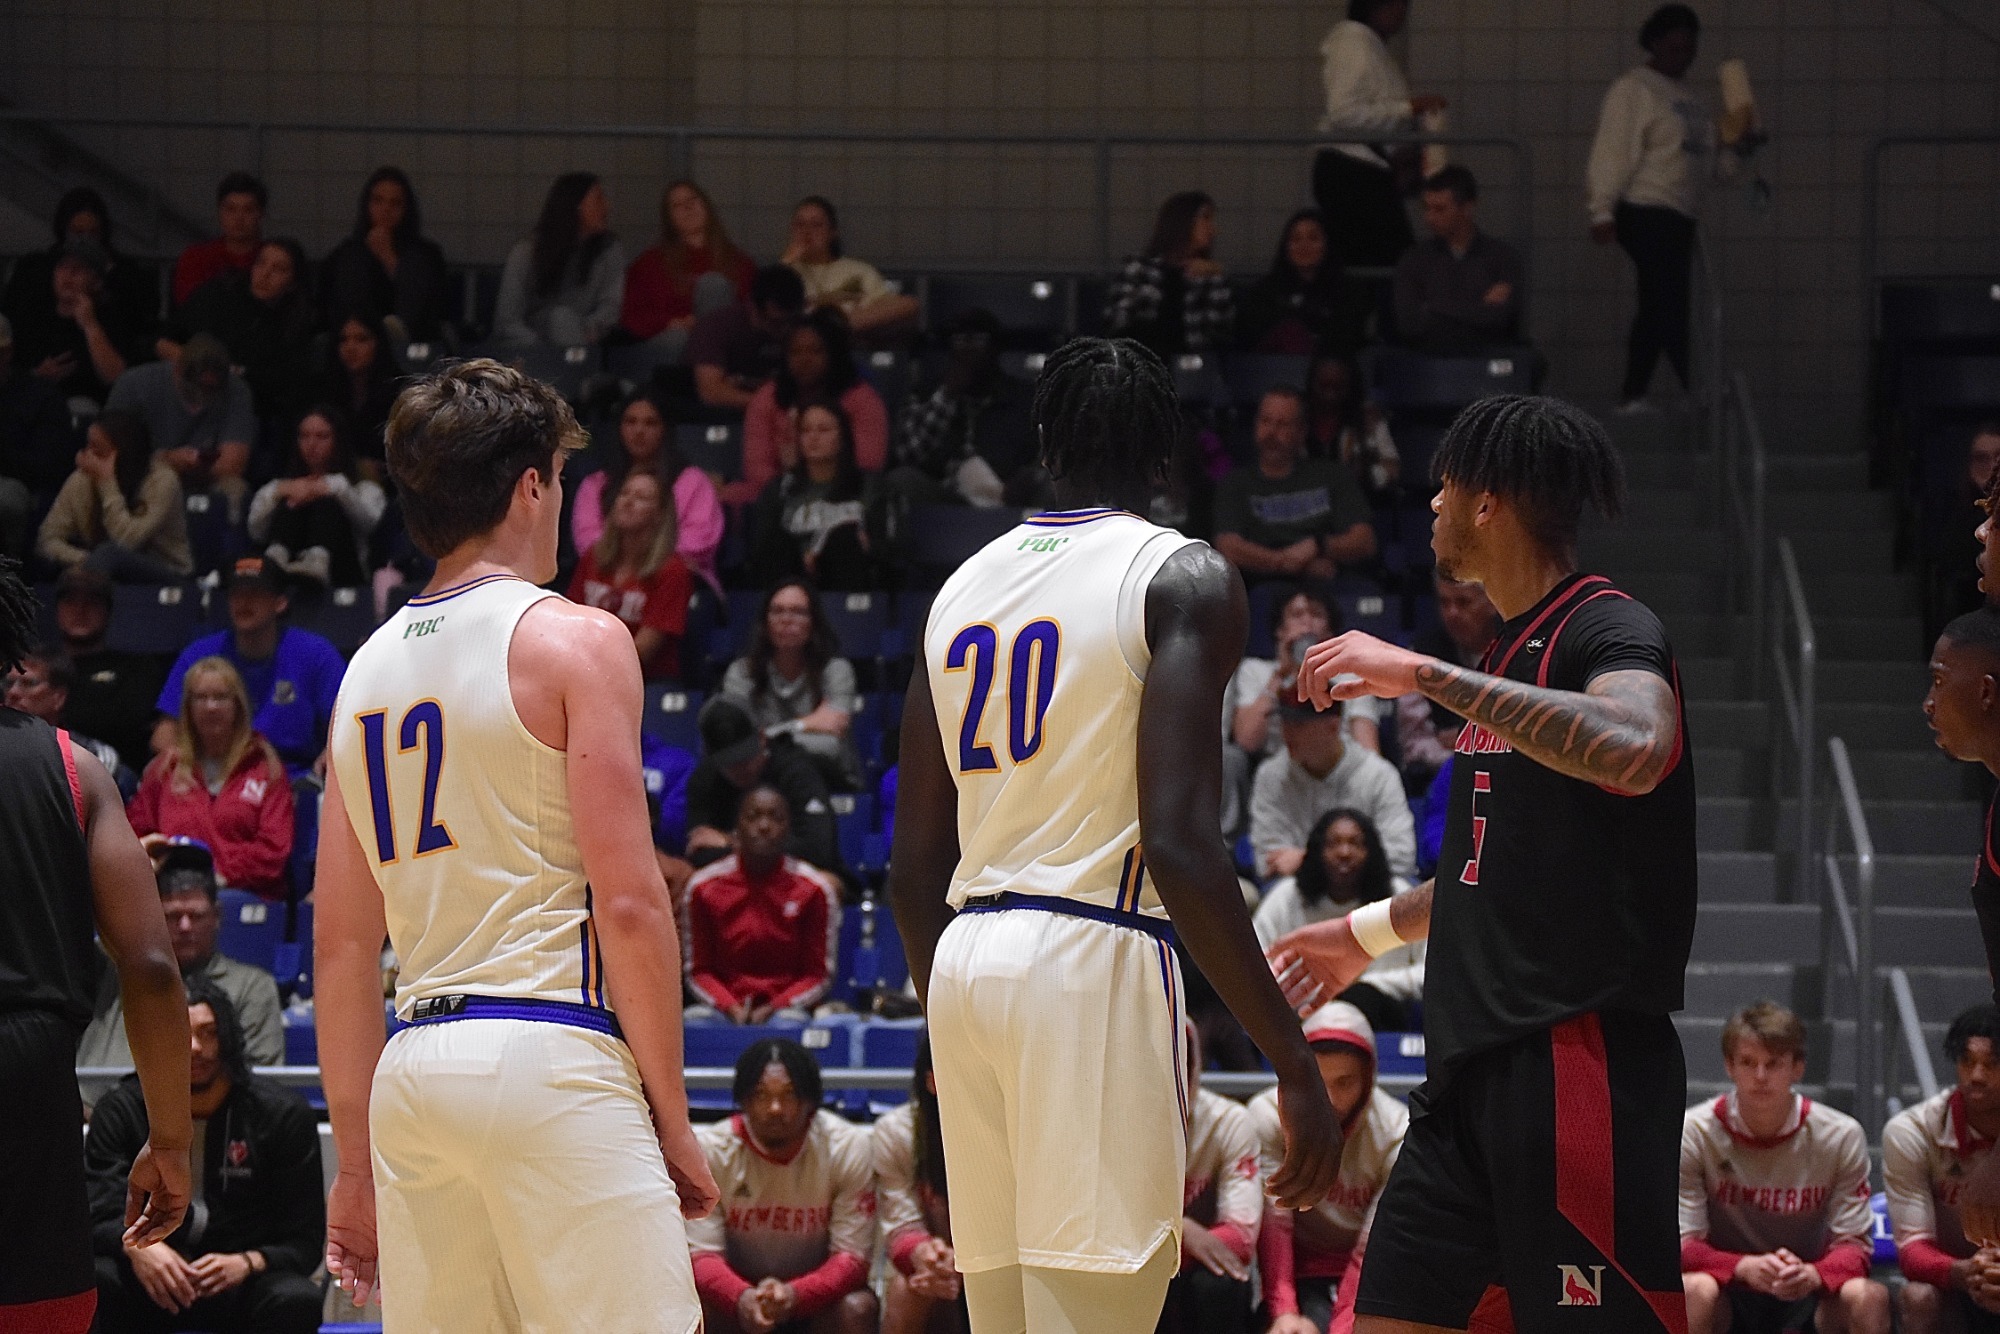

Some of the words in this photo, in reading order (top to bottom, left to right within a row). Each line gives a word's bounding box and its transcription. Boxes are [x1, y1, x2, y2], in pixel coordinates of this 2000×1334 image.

[1015, 536, 1070, 553] PBC
[402, 615, 445, 640] PBC
[943, 615, 1062, 776] 20
[354, 697, 459, 867] 12
[1556, 1264, 1607, 1306] N
